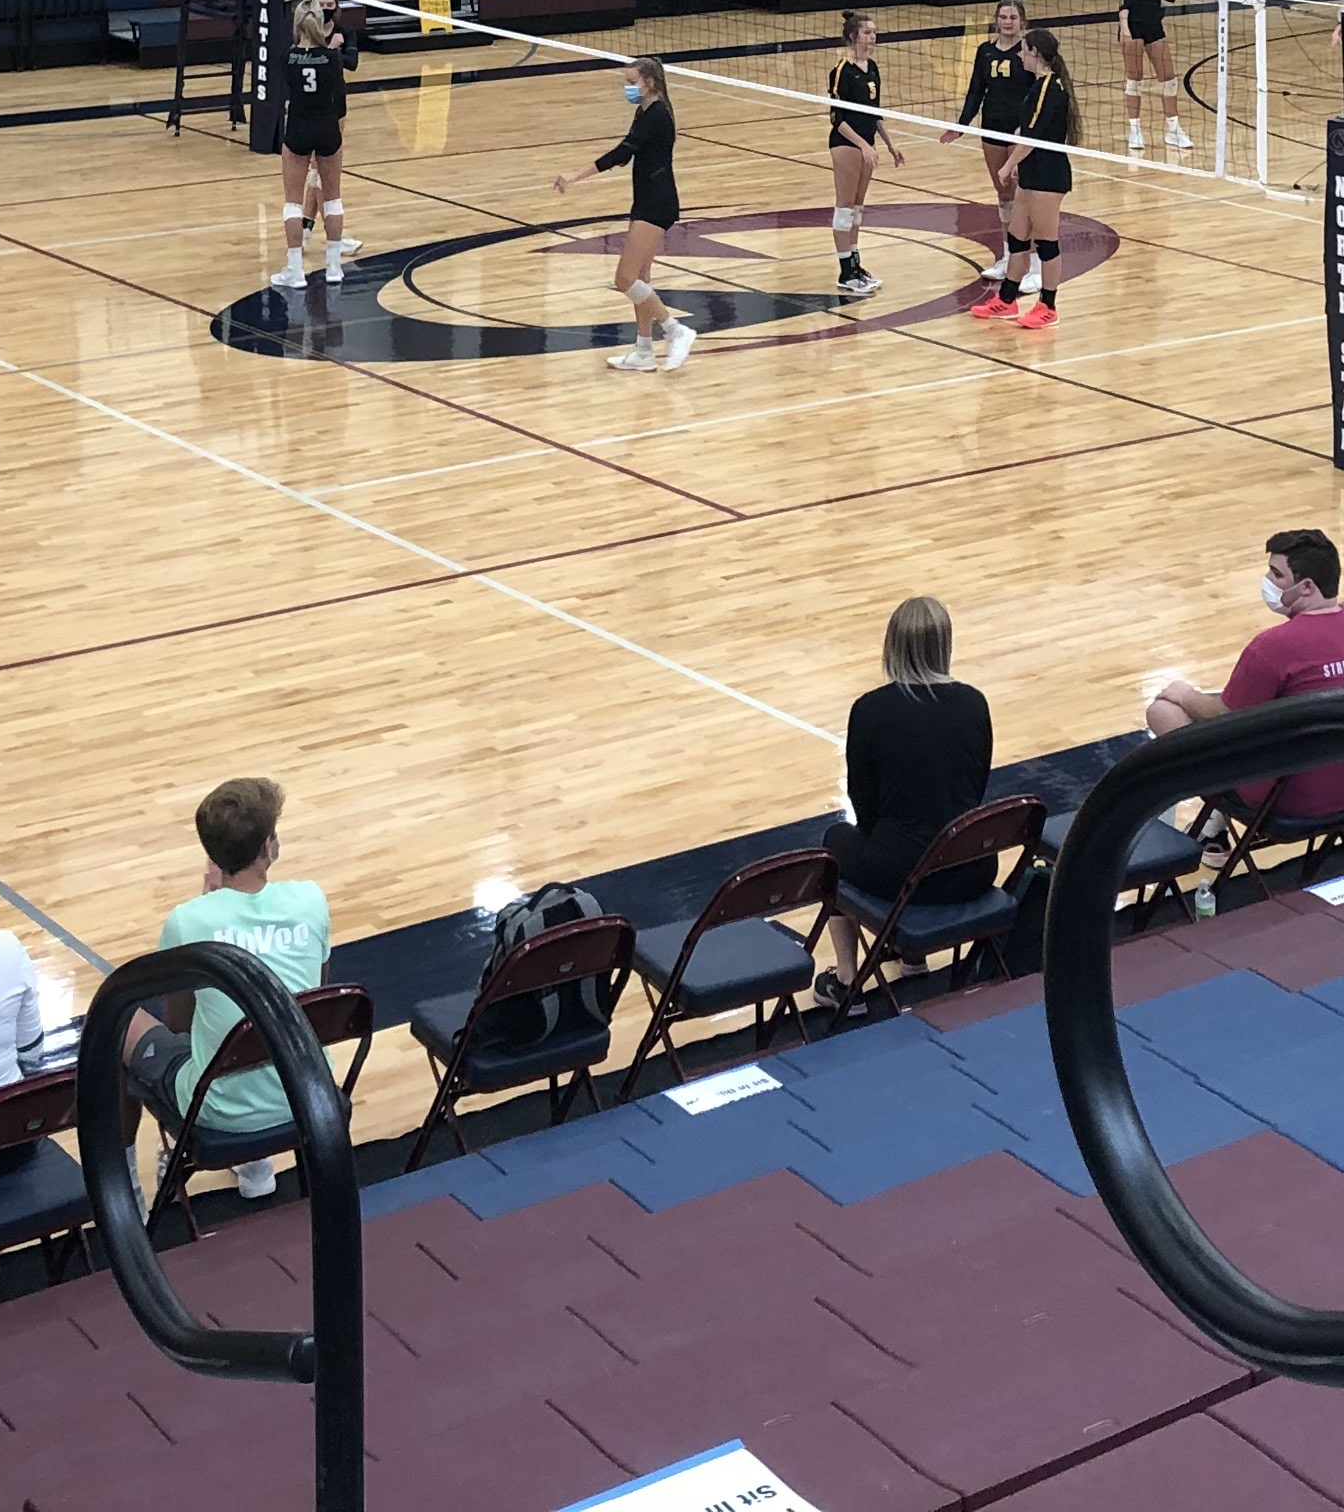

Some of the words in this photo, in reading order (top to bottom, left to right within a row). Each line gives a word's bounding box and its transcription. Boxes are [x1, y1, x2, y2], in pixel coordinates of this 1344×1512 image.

[990, 59, 1011, 78] 14
[302, 68, 316, 92] 3
[736, 1484, 778, 1506] Sit
